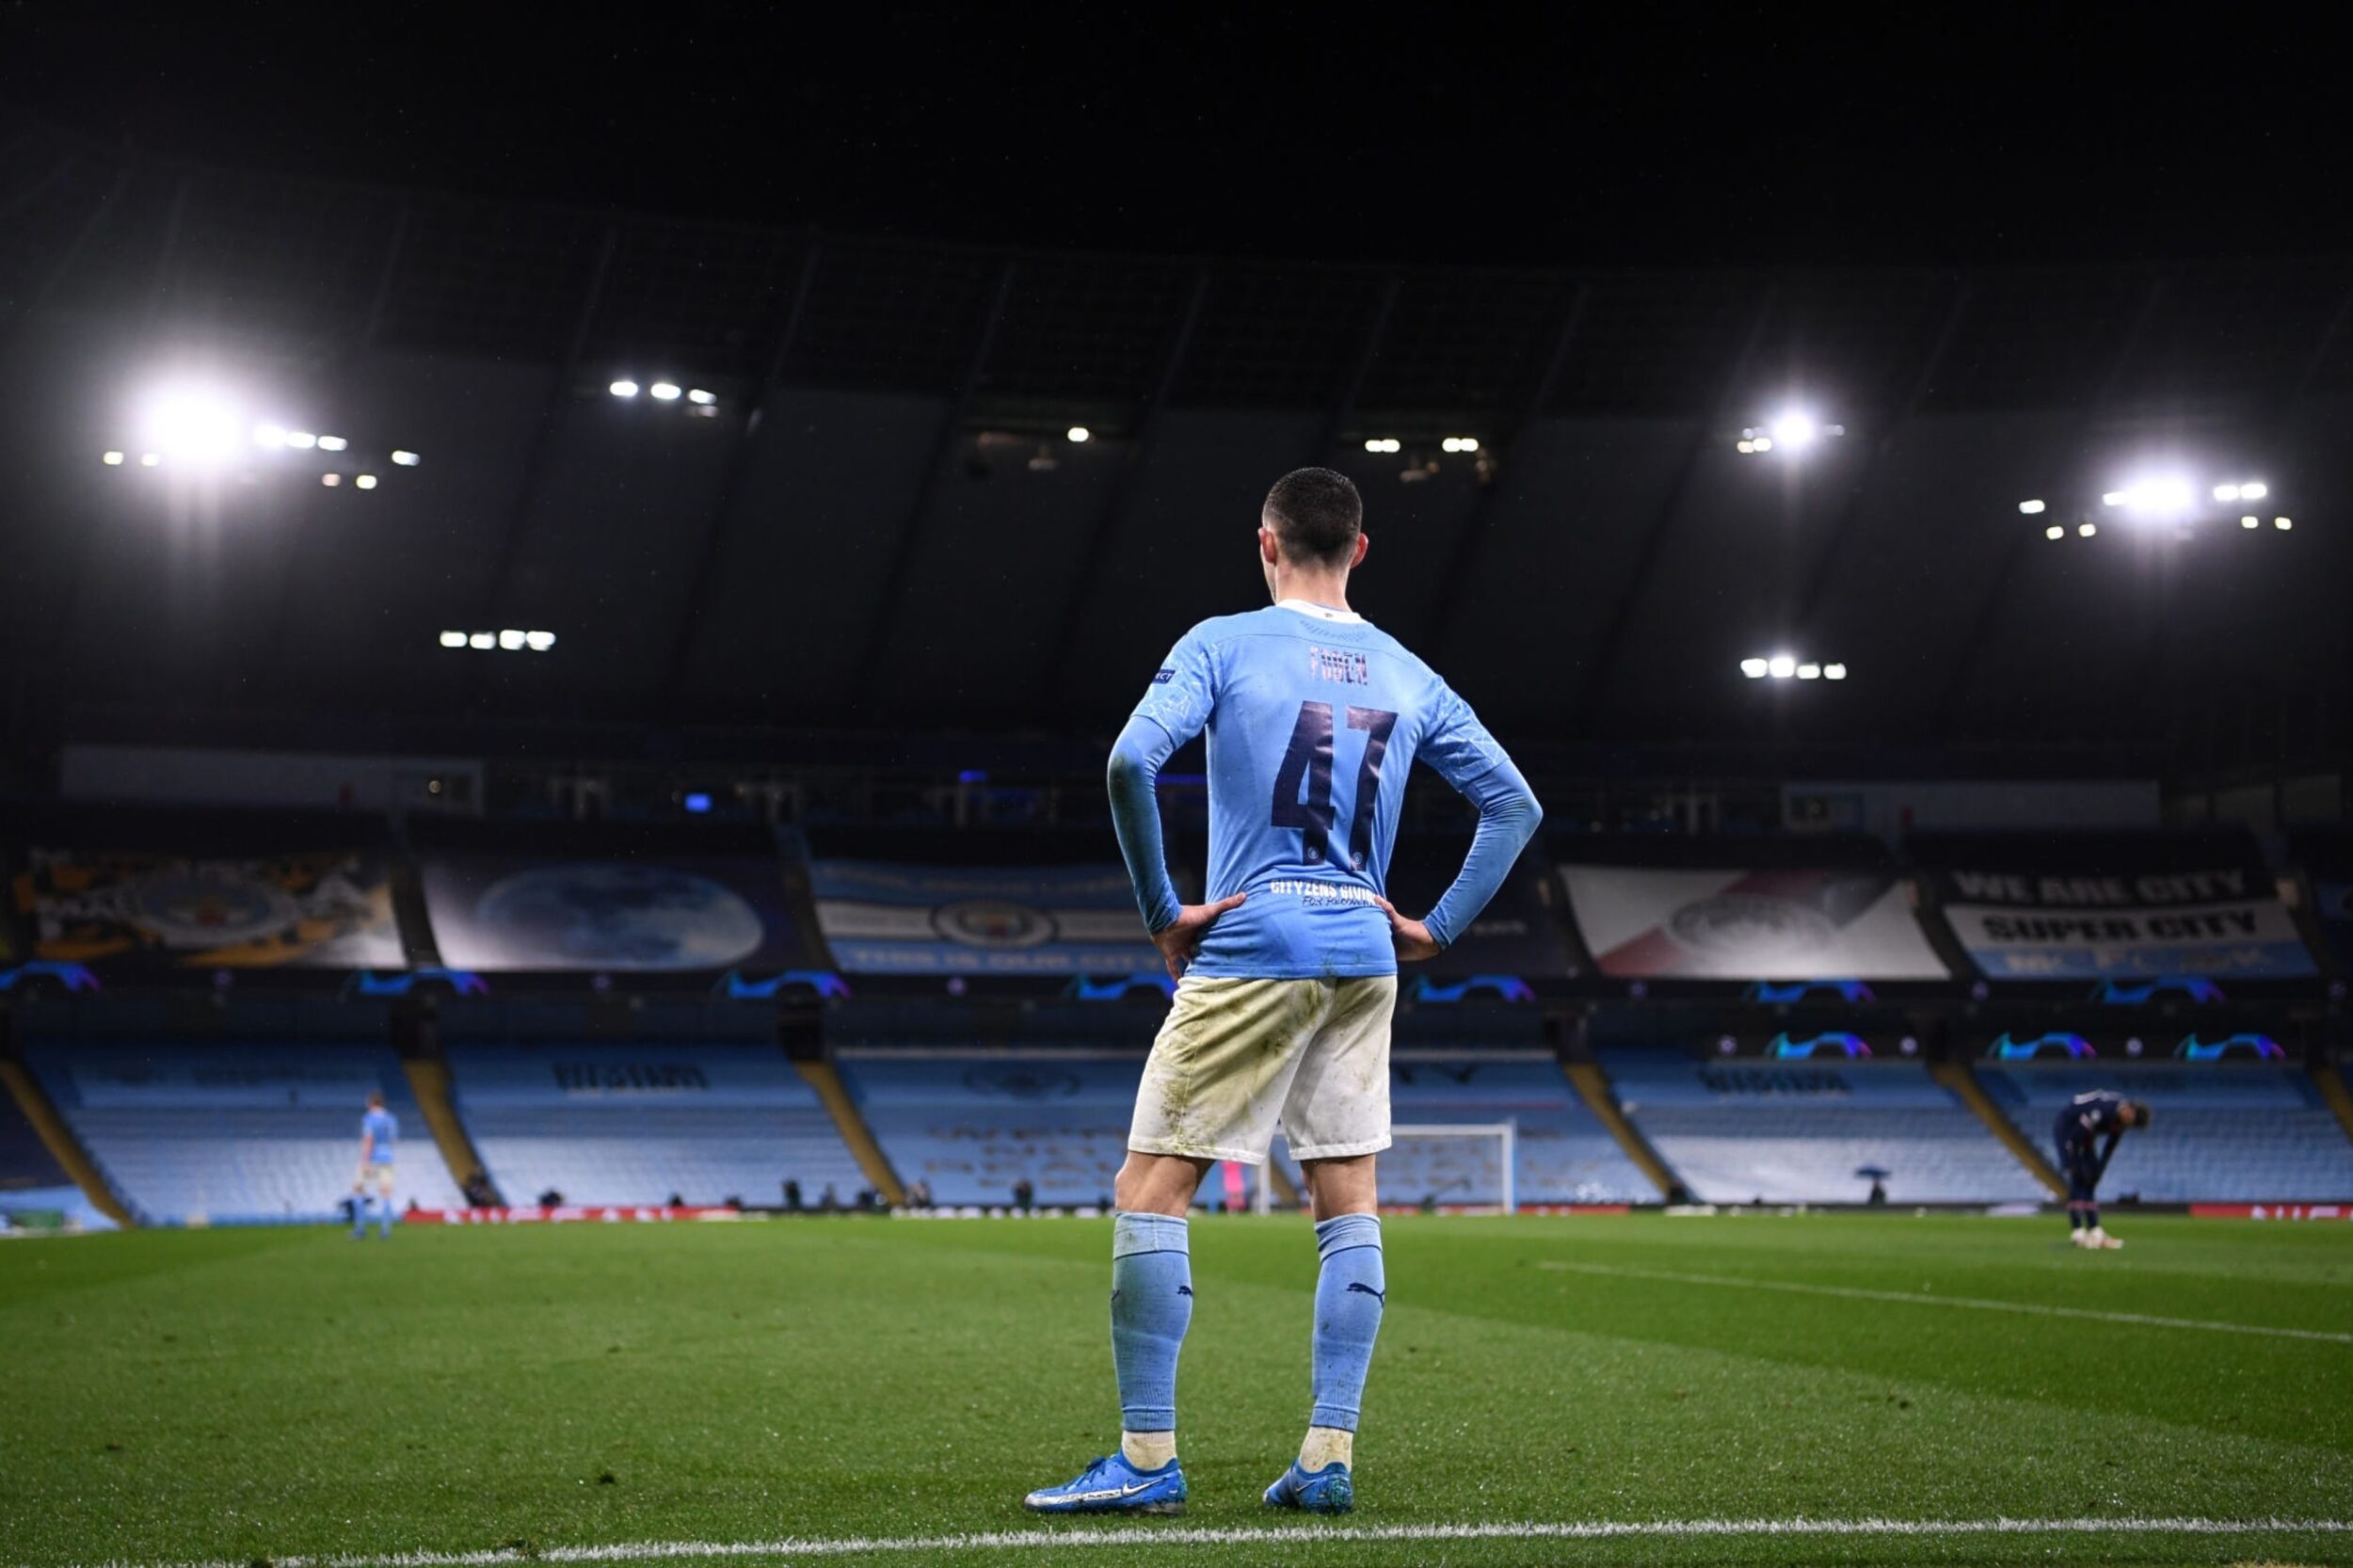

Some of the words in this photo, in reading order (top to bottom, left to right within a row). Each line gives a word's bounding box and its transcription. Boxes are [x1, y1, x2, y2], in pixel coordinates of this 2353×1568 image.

[1310, 647, 1368, 685] FODEN
[1271, 700, 1399, 872] 47
[1271, 881, 1337, 897] CITYZENS
[1951, 870, 2033, 904] WE
[2036, 875, 2131, 904] ARE
[2136, 868, 2245, 902] CITY
[1981, 915, 2137, 941] SUPER
[2146, 909, 2255, 940] CITY
